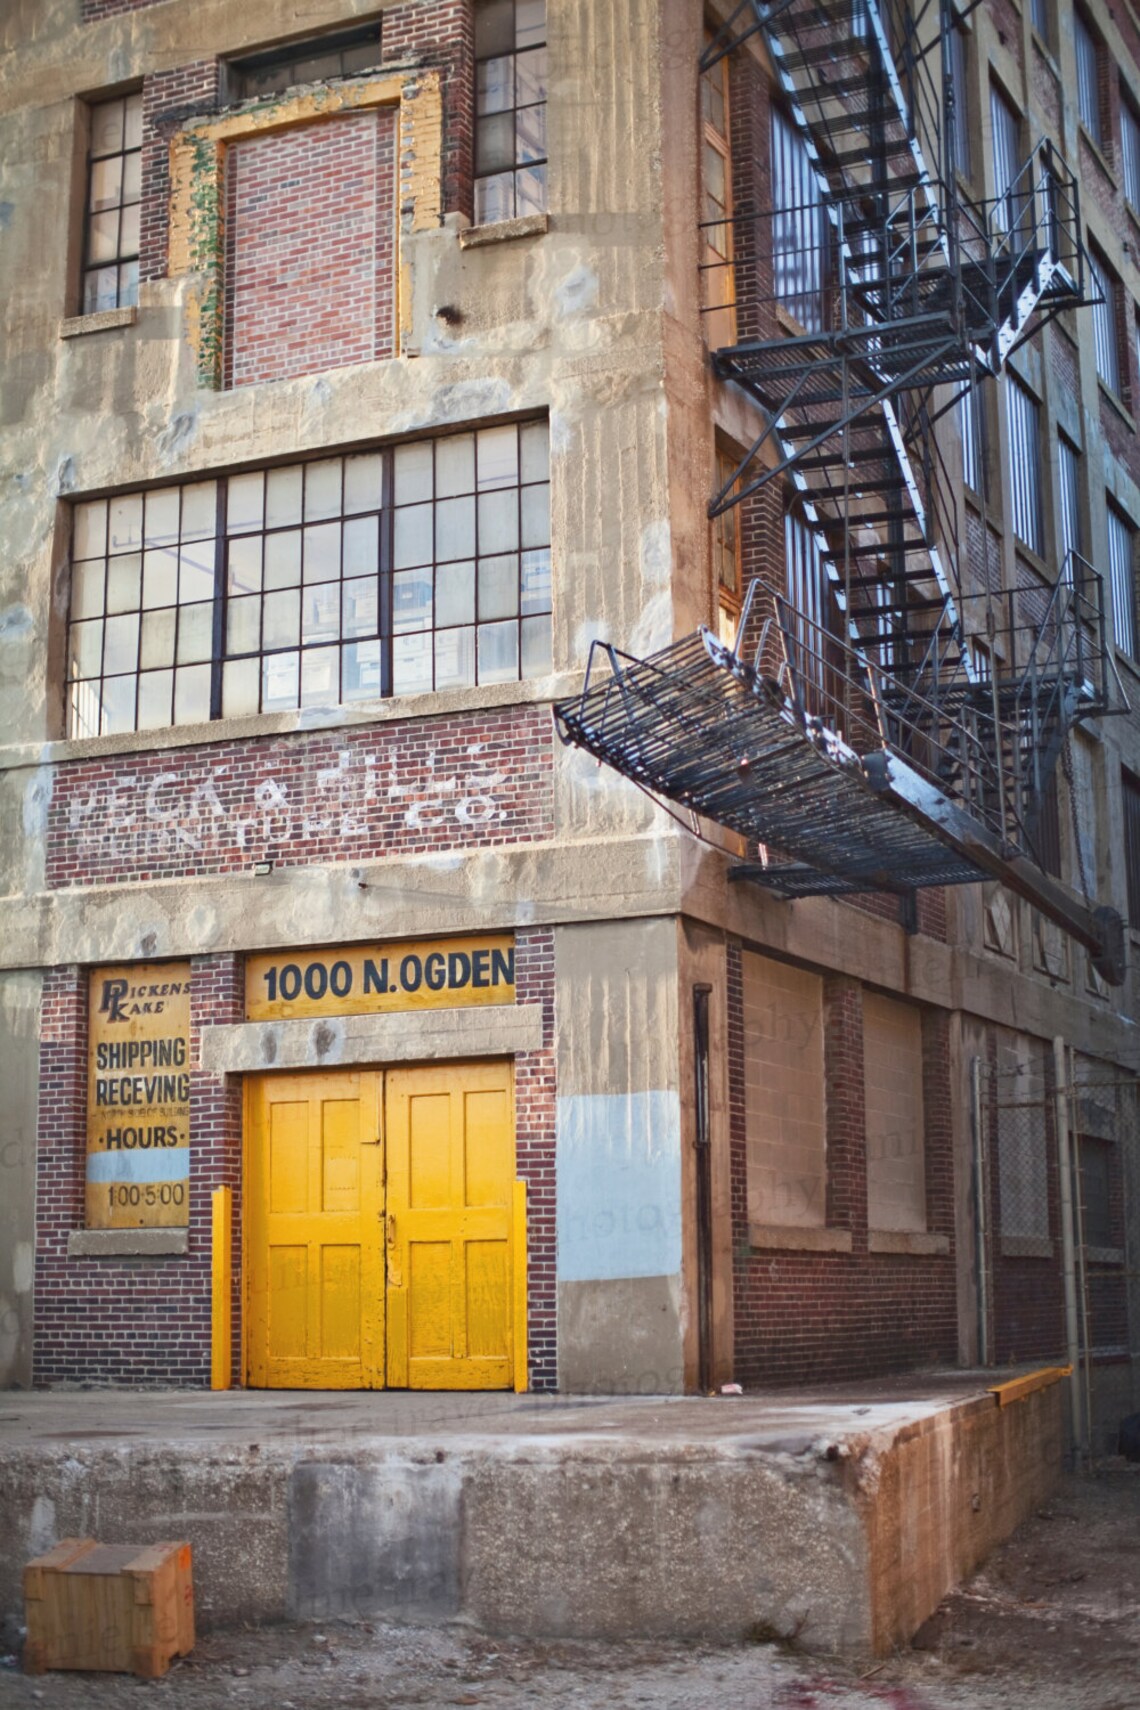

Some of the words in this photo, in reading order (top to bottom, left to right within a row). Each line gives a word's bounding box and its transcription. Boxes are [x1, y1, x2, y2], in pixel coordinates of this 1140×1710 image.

[264, 961, 353, 1001] 1000
[96, 1037, 186, 1071] SHIPPING
[96, 1073, 190, 1107] RECEVING
